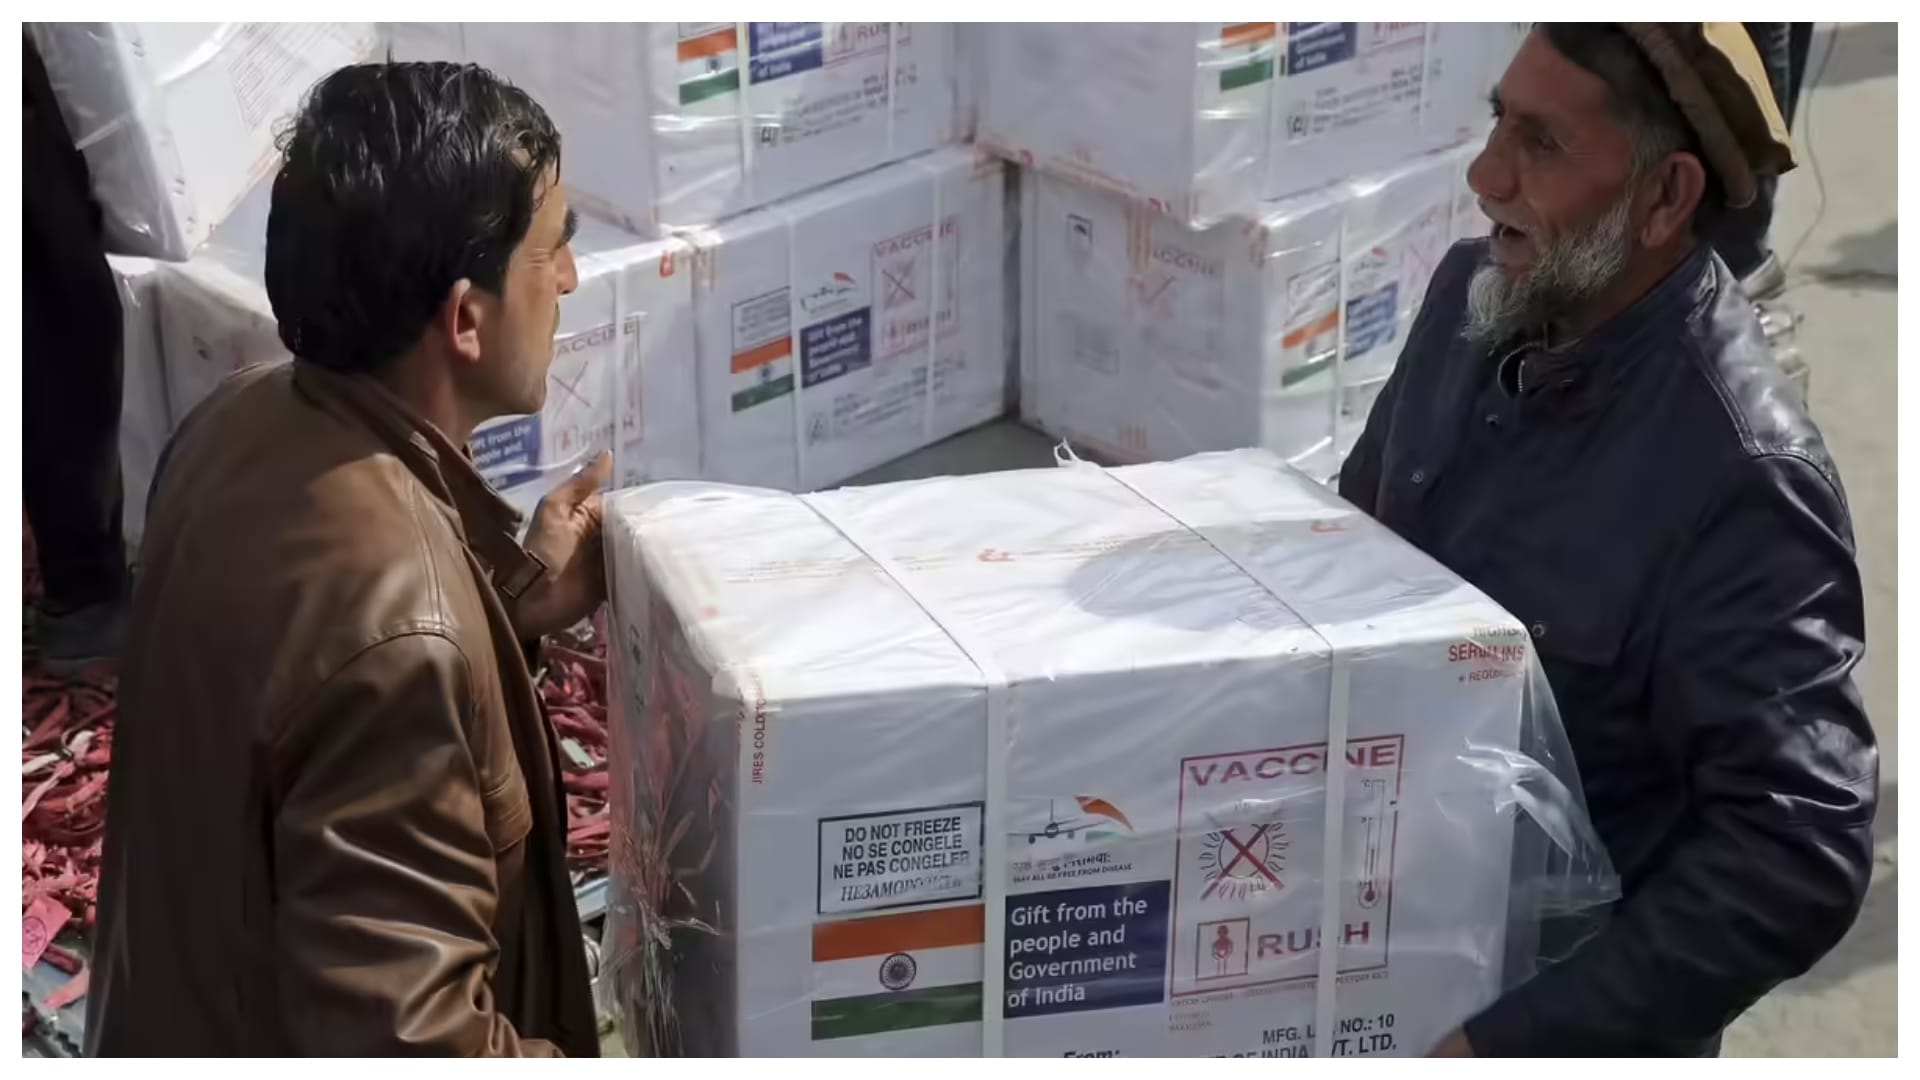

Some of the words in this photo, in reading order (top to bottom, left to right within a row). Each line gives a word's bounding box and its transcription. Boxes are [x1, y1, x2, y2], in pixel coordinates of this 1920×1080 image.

[753, 713, 766, 750] COLD
[1188, 743, 1398, 787] VACCNE
[845, 827, 867, 844] DO
[870, 823, 901, 841] NOT
[904, 816, 961, 837] FREEZE
[842, 845, 864, 862] NO
[868, 842, 888, 858] SE
[891, 834, 963, 856] CONGELE
[833, 863, 854, 880] NE
[857, 860, 886, 877] PAS
[889, 850, 971, 873] CONGELER
[1078, 867, 1100, 877] FROM
[1101, 863, 1134, 873] DISEASE
[1011, 904, 1051, 926] Gift
[1057, 902, 1107, 923] from
[1113, 896, 1149, 916] the
[1009, 930, 1081, 958] people
[1087, 924, 1126, 946] and
[1257, 921, 1371, 959] RUH
[1008, 952, 1137, 981] Government
[1007, 987, 1029, 1008] of
[1035, 983, 1086, 1006] India
[1263, 1026, 1302, 1045] MFG.
[1340, 1016, 1373, 1035] NO.:
[1377, 1013, 1395, 1029] 10
[1358, 1033, 1397, 1054] LTD.
